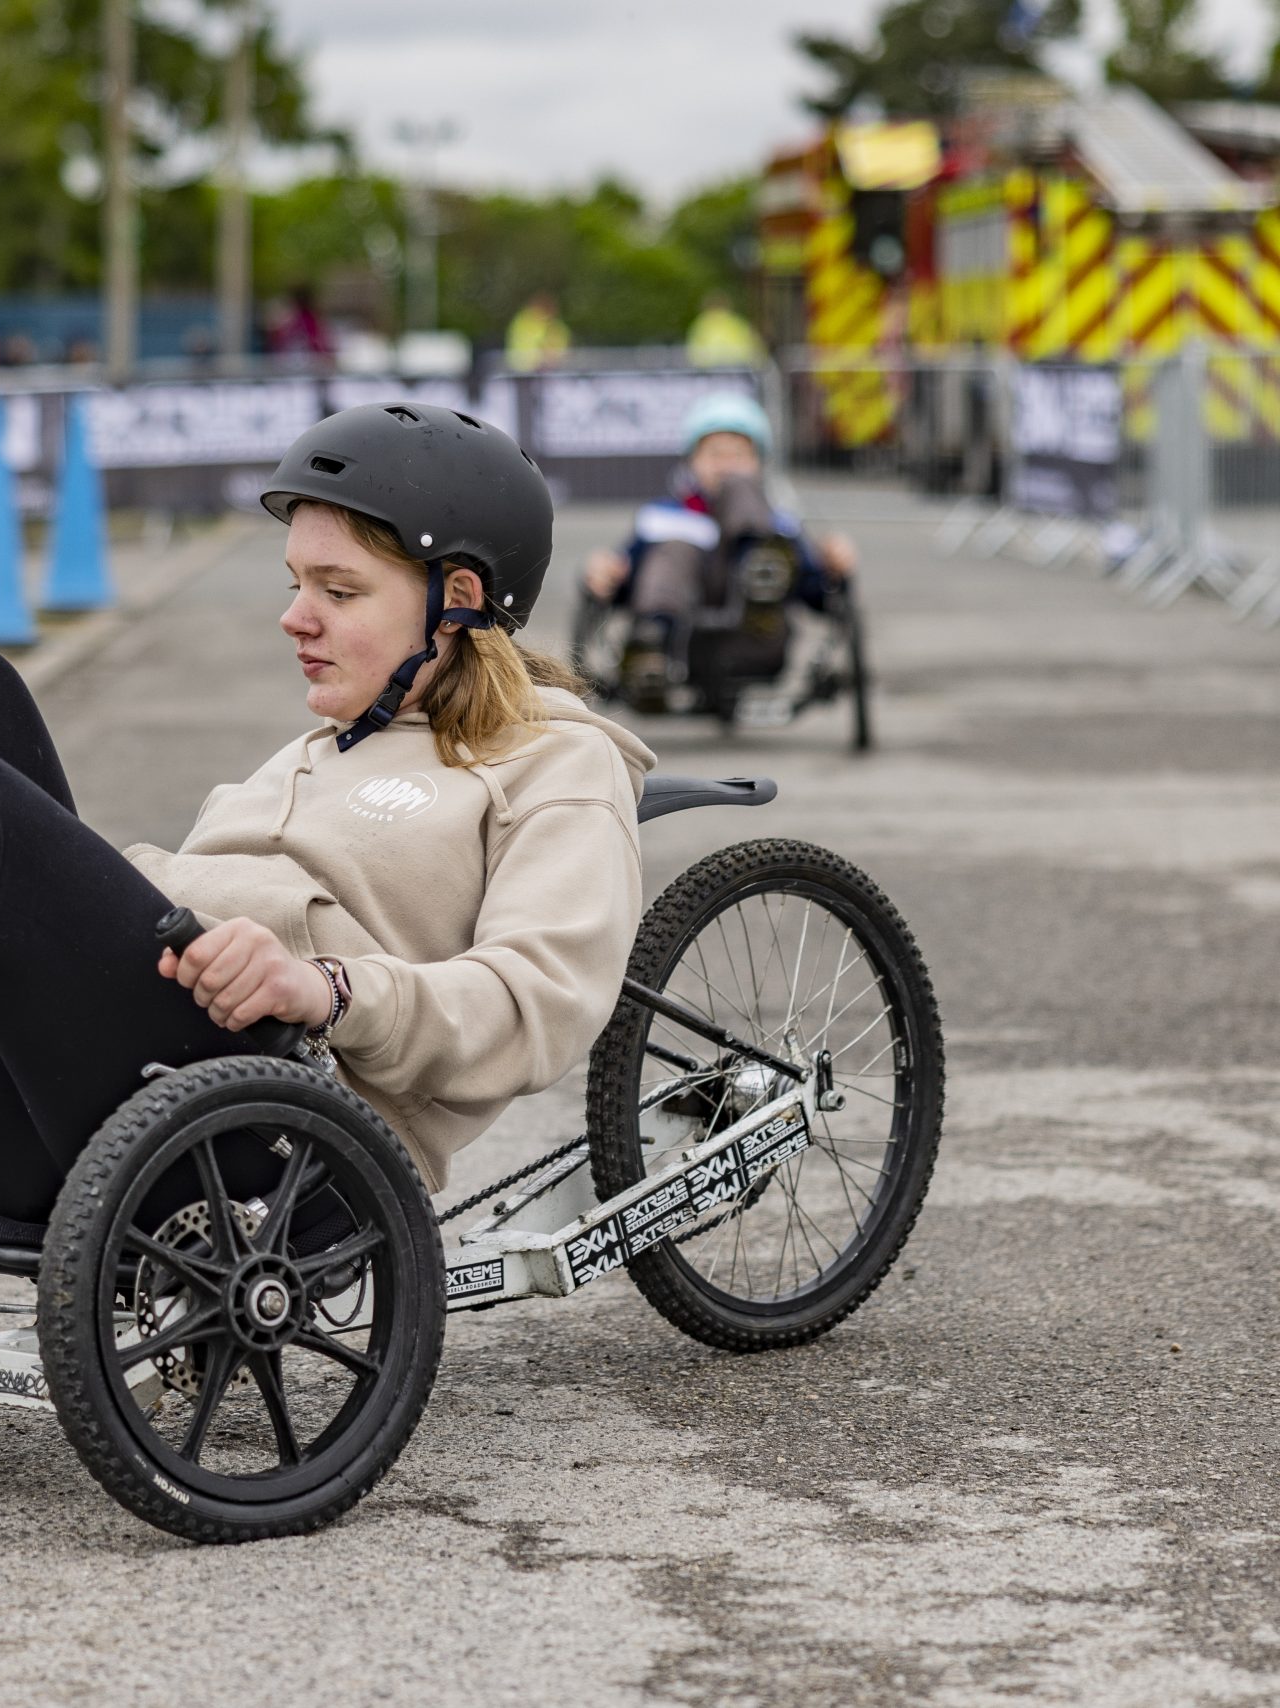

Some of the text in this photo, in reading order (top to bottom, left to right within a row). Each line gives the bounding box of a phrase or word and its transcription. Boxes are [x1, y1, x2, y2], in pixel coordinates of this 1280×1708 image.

[741, 1116, 796, 1153] EXTRE
[686, 1147, 737, 1194] EXW
[622, 1177, 687, 1226] EXTREME
[567, 1219, 618, 1267] EXW
[629, 1205, 696, 1253] EXTREME
[446, 1261, 502, 1287] XTREME
